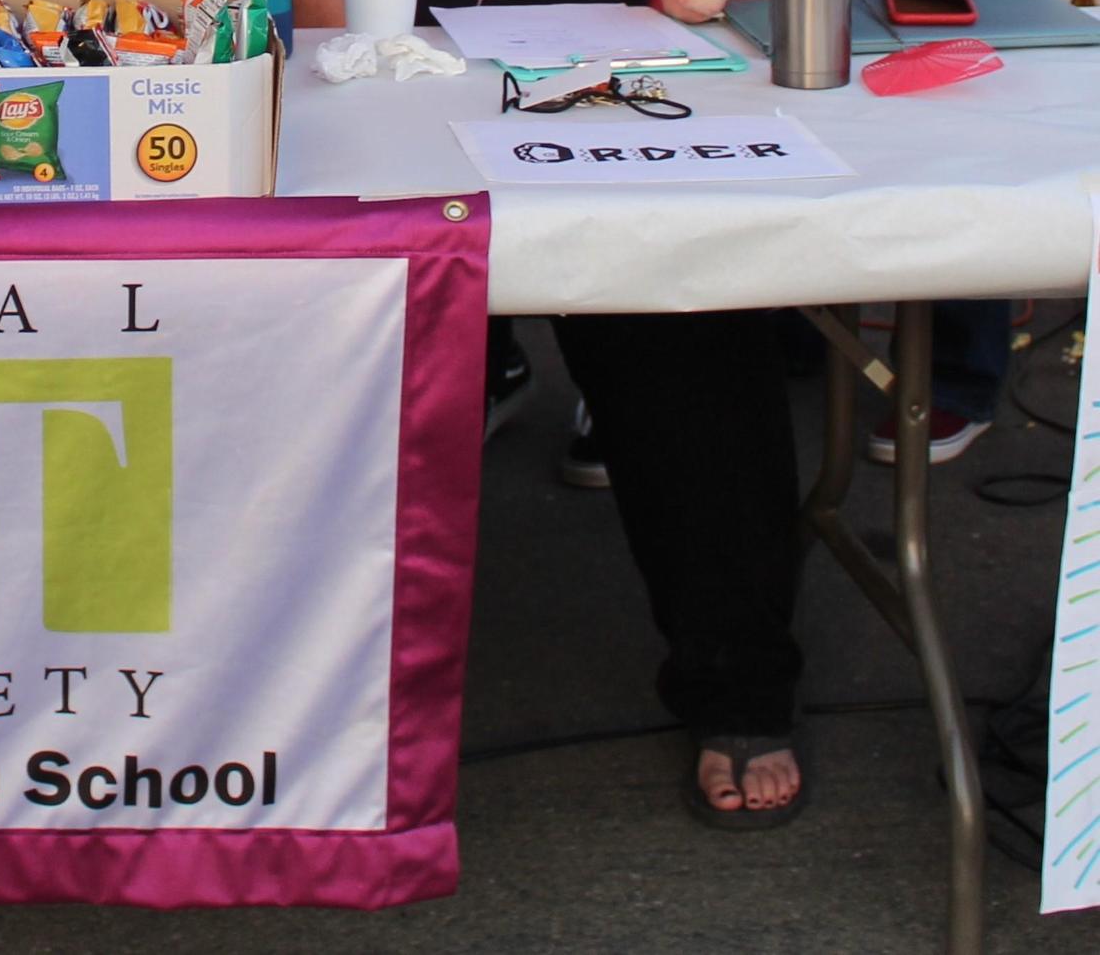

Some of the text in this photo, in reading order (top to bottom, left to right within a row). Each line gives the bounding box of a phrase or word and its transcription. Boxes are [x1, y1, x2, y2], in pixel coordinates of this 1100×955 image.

[131, 78, 201, 96] Classic
[1, 99, 40, 120] Lay's
[148, 99, 184, 115] Mix
[149, 136, 185, 161] 50
[513, 142, 790, 164] ORDER
[40, 168, 48, 178] 4
[149, 163, 184, 174] Singles
[24, 751, 277, 810] School
